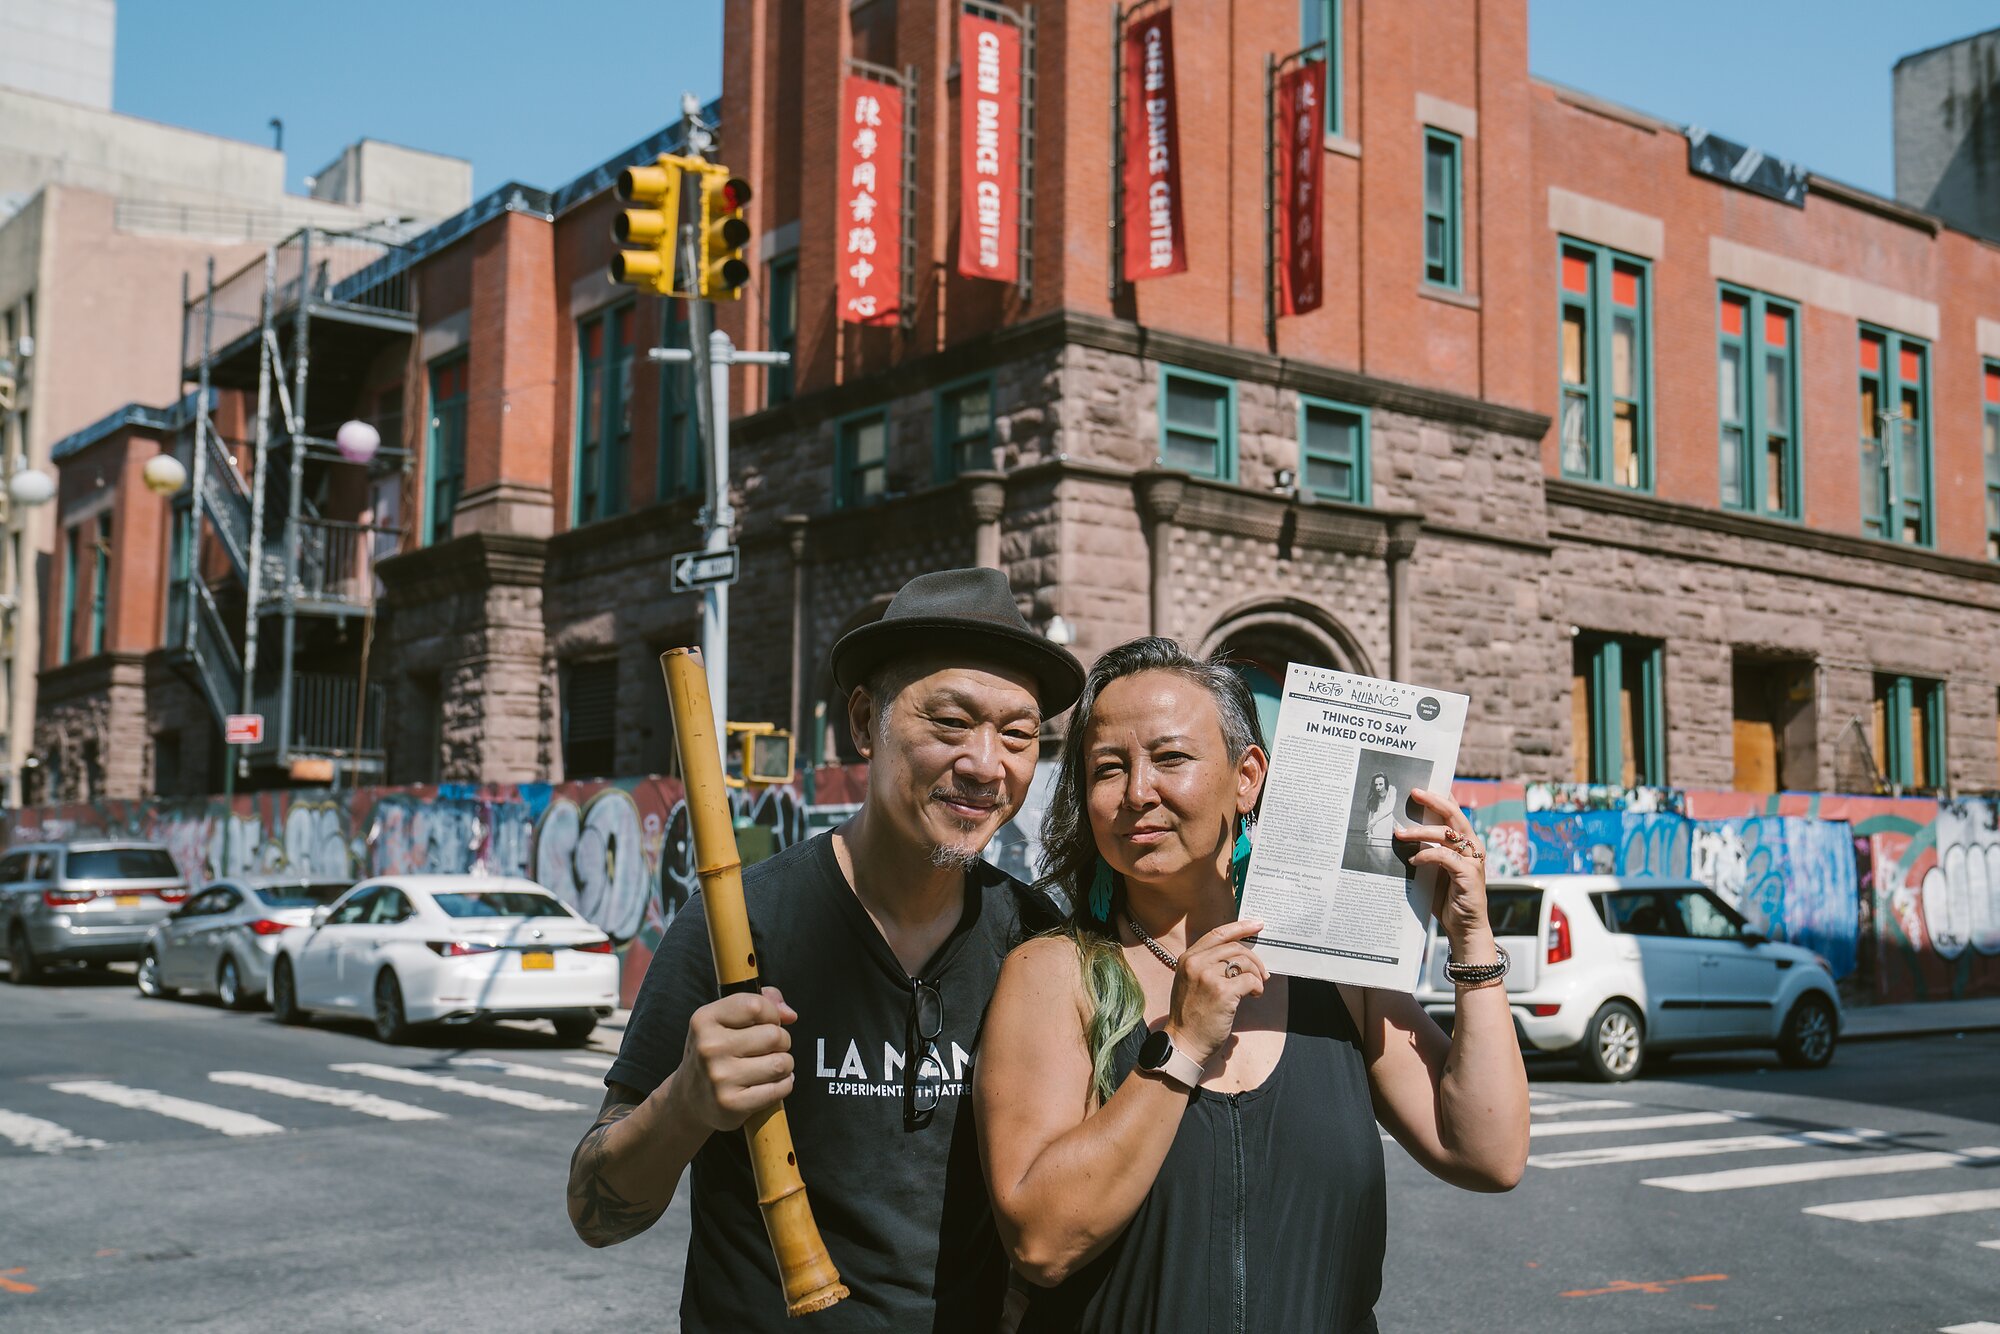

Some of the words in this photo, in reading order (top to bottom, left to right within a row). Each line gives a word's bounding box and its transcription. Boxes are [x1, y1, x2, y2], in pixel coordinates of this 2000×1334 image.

[978, 31, 999, 94] CHEN
[1145, 27, 1164, 91] CHEN
[977, 99, 999, 176] DANCE
[1146, 98, 1169, 176] DANCE
[977, 181, 1000, 268] CENTER
[1149, 180, 1172, 270] CENTER
[1294, 668, 1334, 680] asian
[1347, 679, 1415, 696] american
[1306, 722, 1319, 733] IN
[1322, 726, 1357, 740] MIXED
[1360, 732, 1416, 751] COMPANY
[1322, 711, 1364, 727] THINGS
[1367, 720, 1382, 730] TO
[1385, 722, 1407, 735] SAY
[816, 1037, 867, 1080] LA
